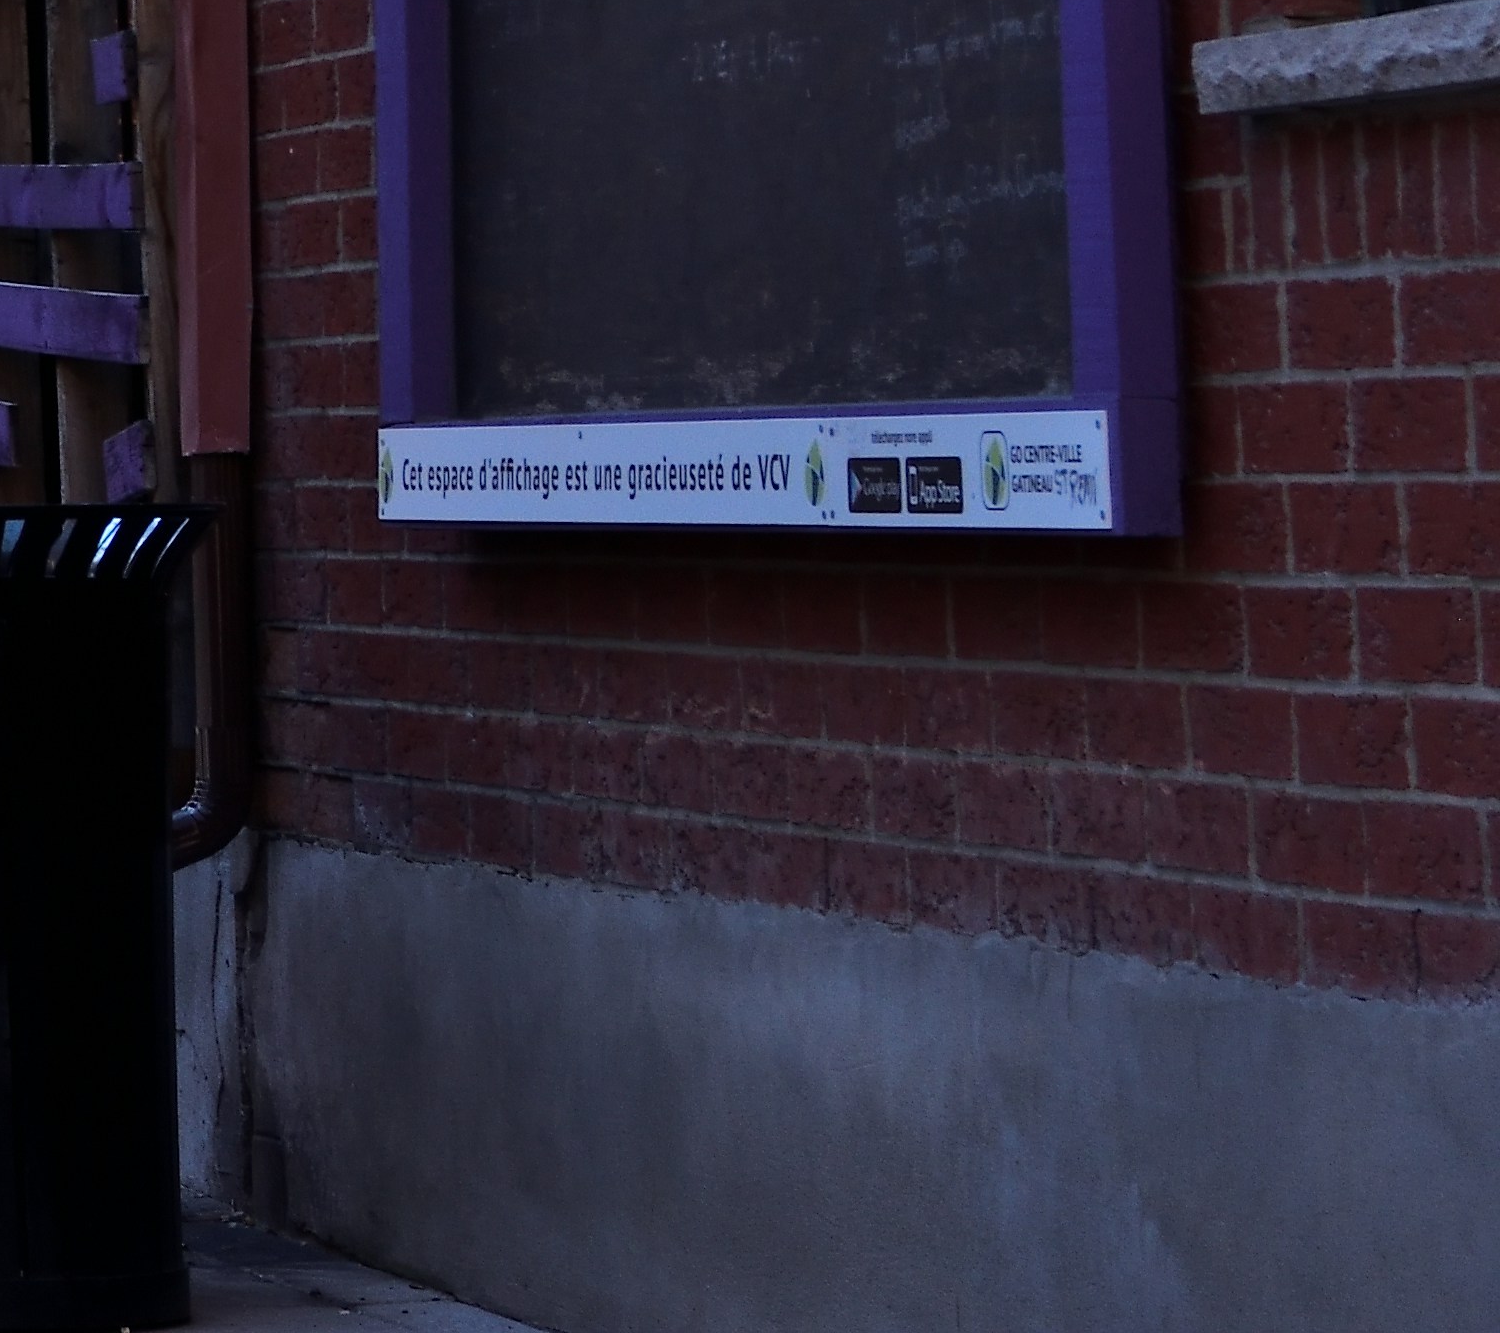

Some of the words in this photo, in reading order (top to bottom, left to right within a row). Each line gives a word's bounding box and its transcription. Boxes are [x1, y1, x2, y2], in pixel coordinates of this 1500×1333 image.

[1024, 444, 1082, 463] CENTRE-VILLE
[402, 458, 424, 492] Cet
[428, 465, 474, 499] espace
[479, 457, 560, 500] d'affichage
[566, 461, 588, 492] est
[594, 469, 621, 492] une
[628, 453, 724, 500] gracieuseté
[731, 455, 752, 491] de
[757, 454, 791, 491] VCV
[1012, 474, 1053, 493] GATINEAU
[919, 482, 937, 508] App
[938, 479, 960, 503] Store
